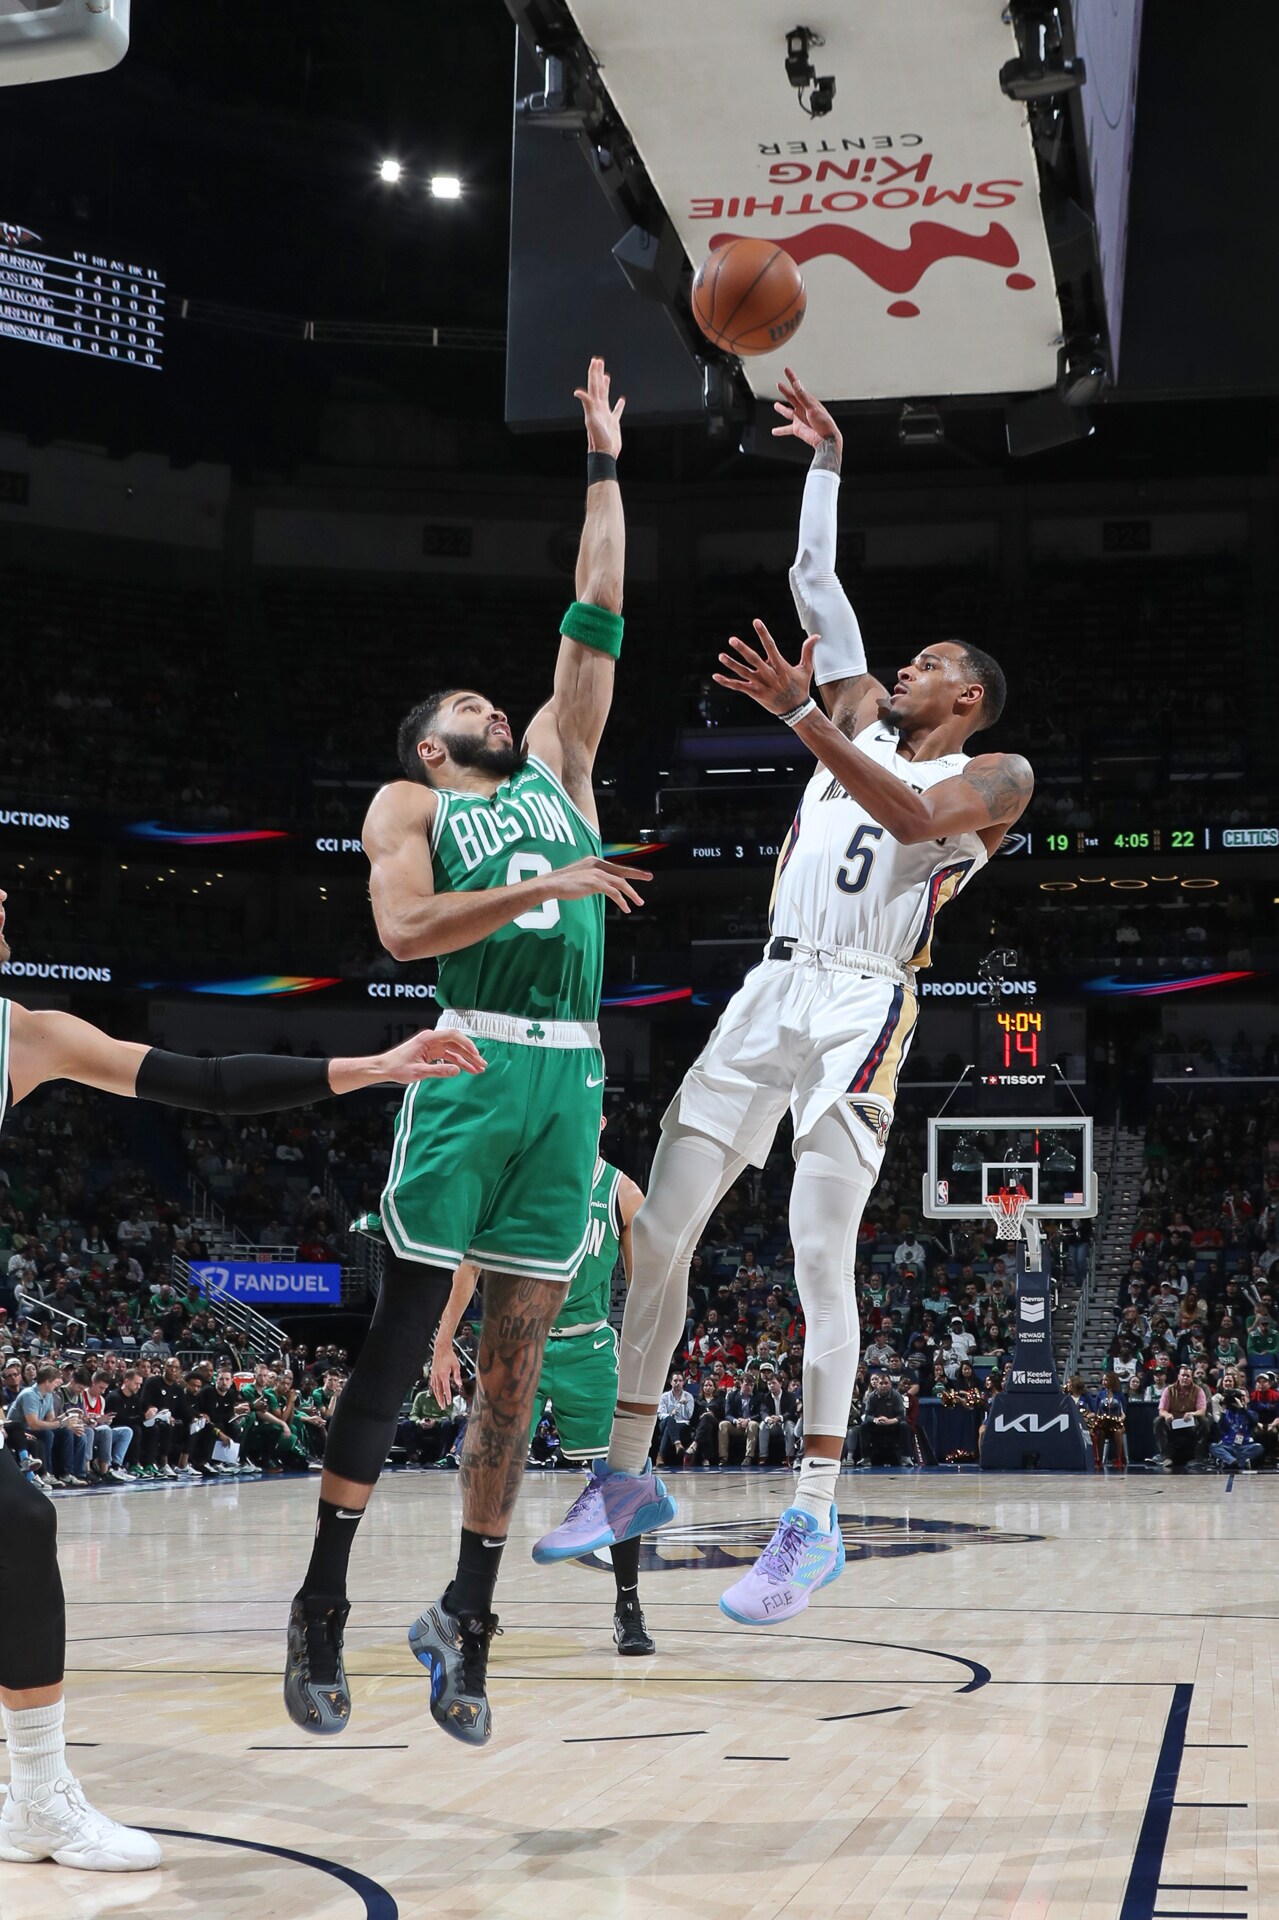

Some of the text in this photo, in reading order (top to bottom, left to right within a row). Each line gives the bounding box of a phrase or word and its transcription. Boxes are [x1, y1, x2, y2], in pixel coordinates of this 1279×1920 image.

[759, 134, 923, 155] CENTER
[688, 179, 1023, 219] SMOOTHIE
[0, 270, 156, 316] OSTON 0 0 0 0 0
[112, 280, 120, 291] 0
[131, 284, 139, 295] 0
[111, 313, 120, 324] 0
[129, 316, 137, 328] 0
[147, 321, 155, 332] 0
[110, 329, 119, 341] 0
[128, 333, 136, 344] 0
[146, 338, 155, 349] 0
[73, 338, 81, 349] 0
[91, 342, 99, 353] 0
[109, 346, 118, 357] 0
[127, 350, 136, 361] 0
[145, 354, 153, 365] 0
[448, 792, 577, 872] BOSTON
[1046, 832, 1195, 850] 19 1st 4:05 22
[1222, 829, 1279, 848] CELTICS
[316, 838, 338, 852] CCI
[693, 848, 721, 858] FOULS
[735, 846, 744, 858] 3
[837, 824, 883, 895] 5
[368, 983, 390, 997] CCI
[922, 981, 1037, 996] PRODUCONS
[997, 1012, 1041, 1032] 4:04
[1004, 1032, 1038, 1068] 14
[998, 1075, 1046, 1085] TISSOT
[234, 1273, 330, 1292] FANDUEL
[1027, 1370, 1052, 1378] Keesler
[1027, 1377, 1052, 1385] Federal
[995, 1413, 1069, 1432] KIA
